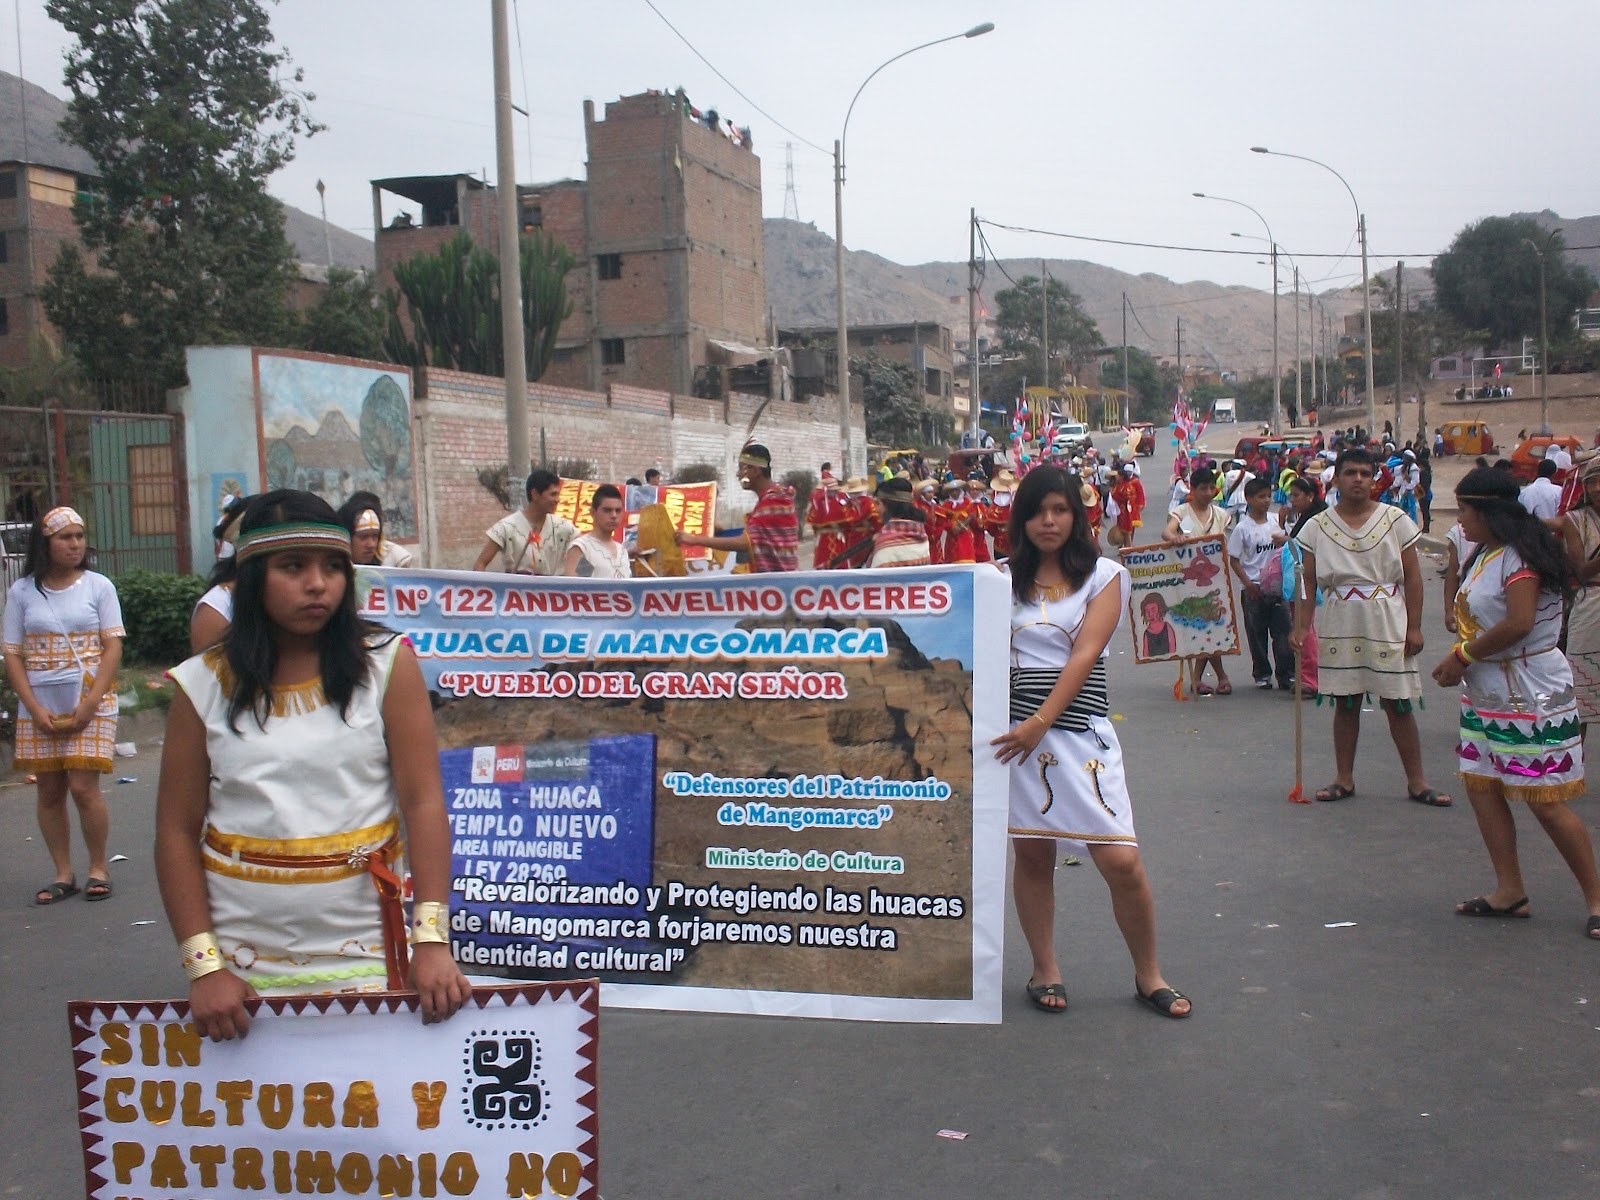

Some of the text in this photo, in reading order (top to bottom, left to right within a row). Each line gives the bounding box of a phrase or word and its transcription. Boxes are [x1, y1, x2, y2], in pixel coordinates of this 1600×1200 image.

[439, 588, 494, 612] 122
[503, 590, 632, 613] ANDRES
[642, 589, 784, 613] AVELINO
[794, 585, 948, 612] CACERES
[409, 631, 884, 654] HUACA DE MANGOMARCA
[440, 669, 845, 697] “PUEBLO DEL GRAN SEÑOR
[496, 755, 521, 772] PERÚ
[452, 788, 503, 809] ZONA
[529, 785, 602, 809] HUACA
[665, 775, 948, 799] “Defensores del Patrimonio
[535, 814, 618, 839] NUEVO
[719, 805, 744, 824] de
[452, 839, 583, 860] AREA INTANGIBLE
[708, 850, 901, 871] Ministerio de Cultura
[464, 859, 503, 882] LEY
[452, 877, 963, 918] “Revalorizando y Protegiendo las huacas
[451, 909, 896, 949] de Mangomarca forjaremos nuestra
[452, 939, 684, 972] Identidad cultural”
[99, 1023, 202, 1067] SIN
[103, 1077, 448, 1130] CULTURA Y
[112, 1141, 583, 1199] PATRIMONIO NO
